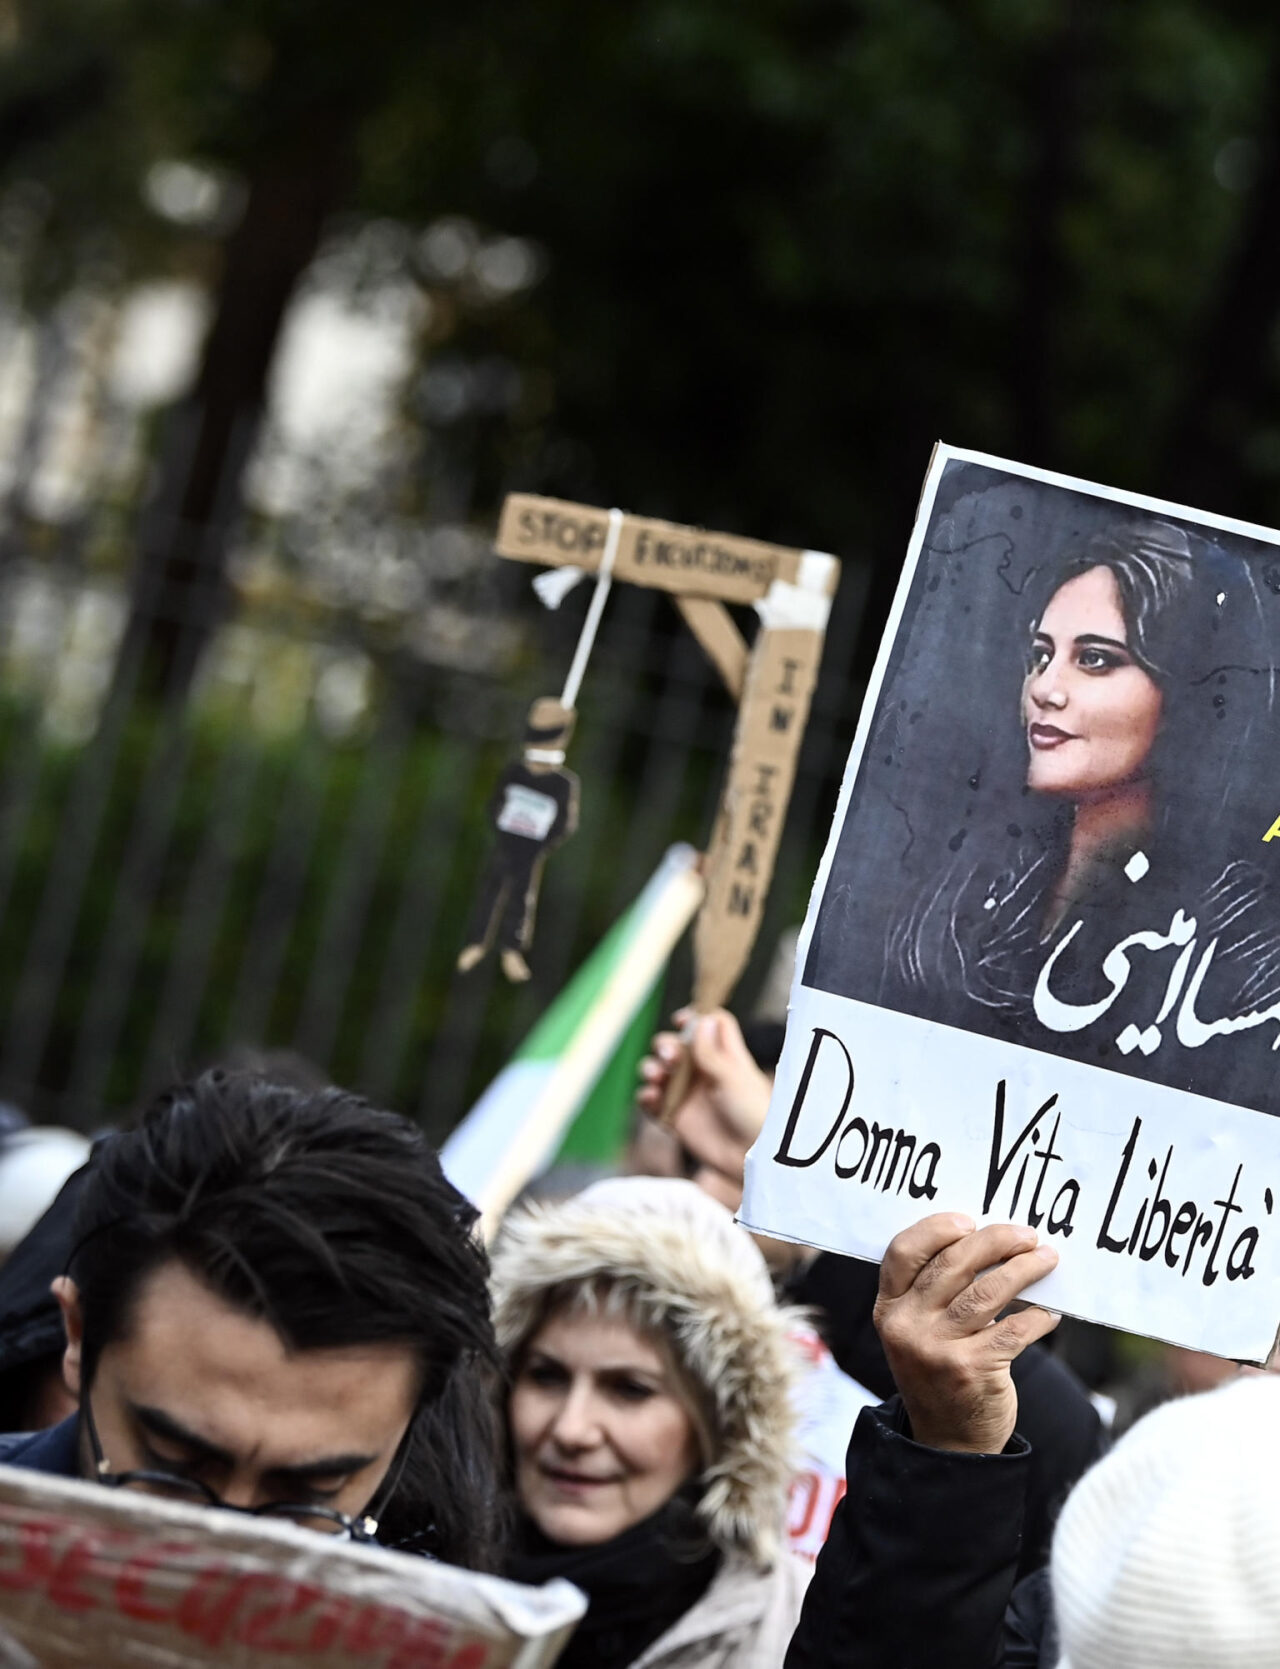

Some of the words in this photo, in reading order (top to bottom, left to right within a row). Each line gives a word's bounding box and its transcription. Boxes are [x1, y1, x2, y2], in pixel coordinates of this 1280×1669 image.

[518, 510, 607, 552] STOP
[769, 656, 802, 735] IN
[727, 763, 777, 917] IRAN
[773, 1027, 943, 1201] Donna
[981, 1078, 1082, 1238] Vita
[1096, 1115, 1275, 1287] Libertà
